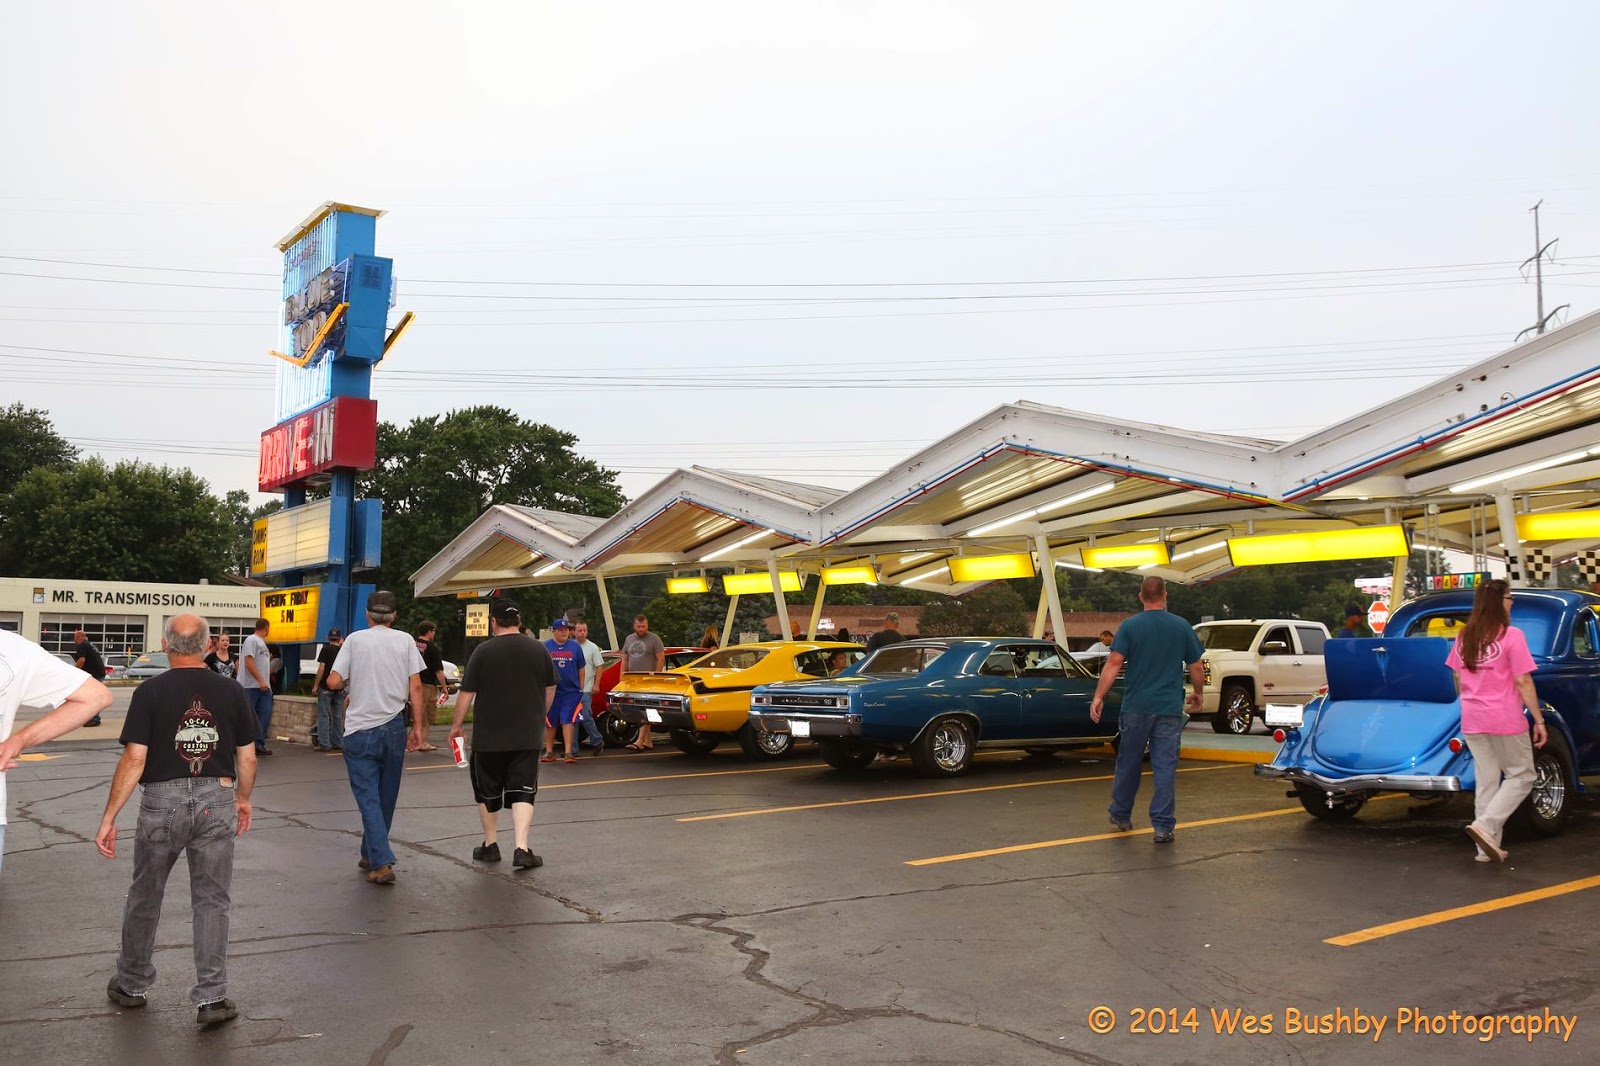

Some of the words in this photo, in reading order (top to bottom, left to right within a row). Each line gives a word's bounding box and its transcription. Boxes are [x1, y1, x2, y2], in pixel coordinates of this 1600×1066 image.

[285, 265, 336, 326] BLUE
[254, 549, 264, 565] ROOM
[52, 590, 78, 603] MR.
[85, 591, 195, 606] TRANSMISSION
[265, 593, 286, 608] OPENING
[290, 590, 309, 606] FRIDAY
[281, 609, 285, 623] 5
[286, 609, 294, 623] PM
[1369, 611, 1389, 623] STOP
[184, 718, 210, 727] SO-CAL
